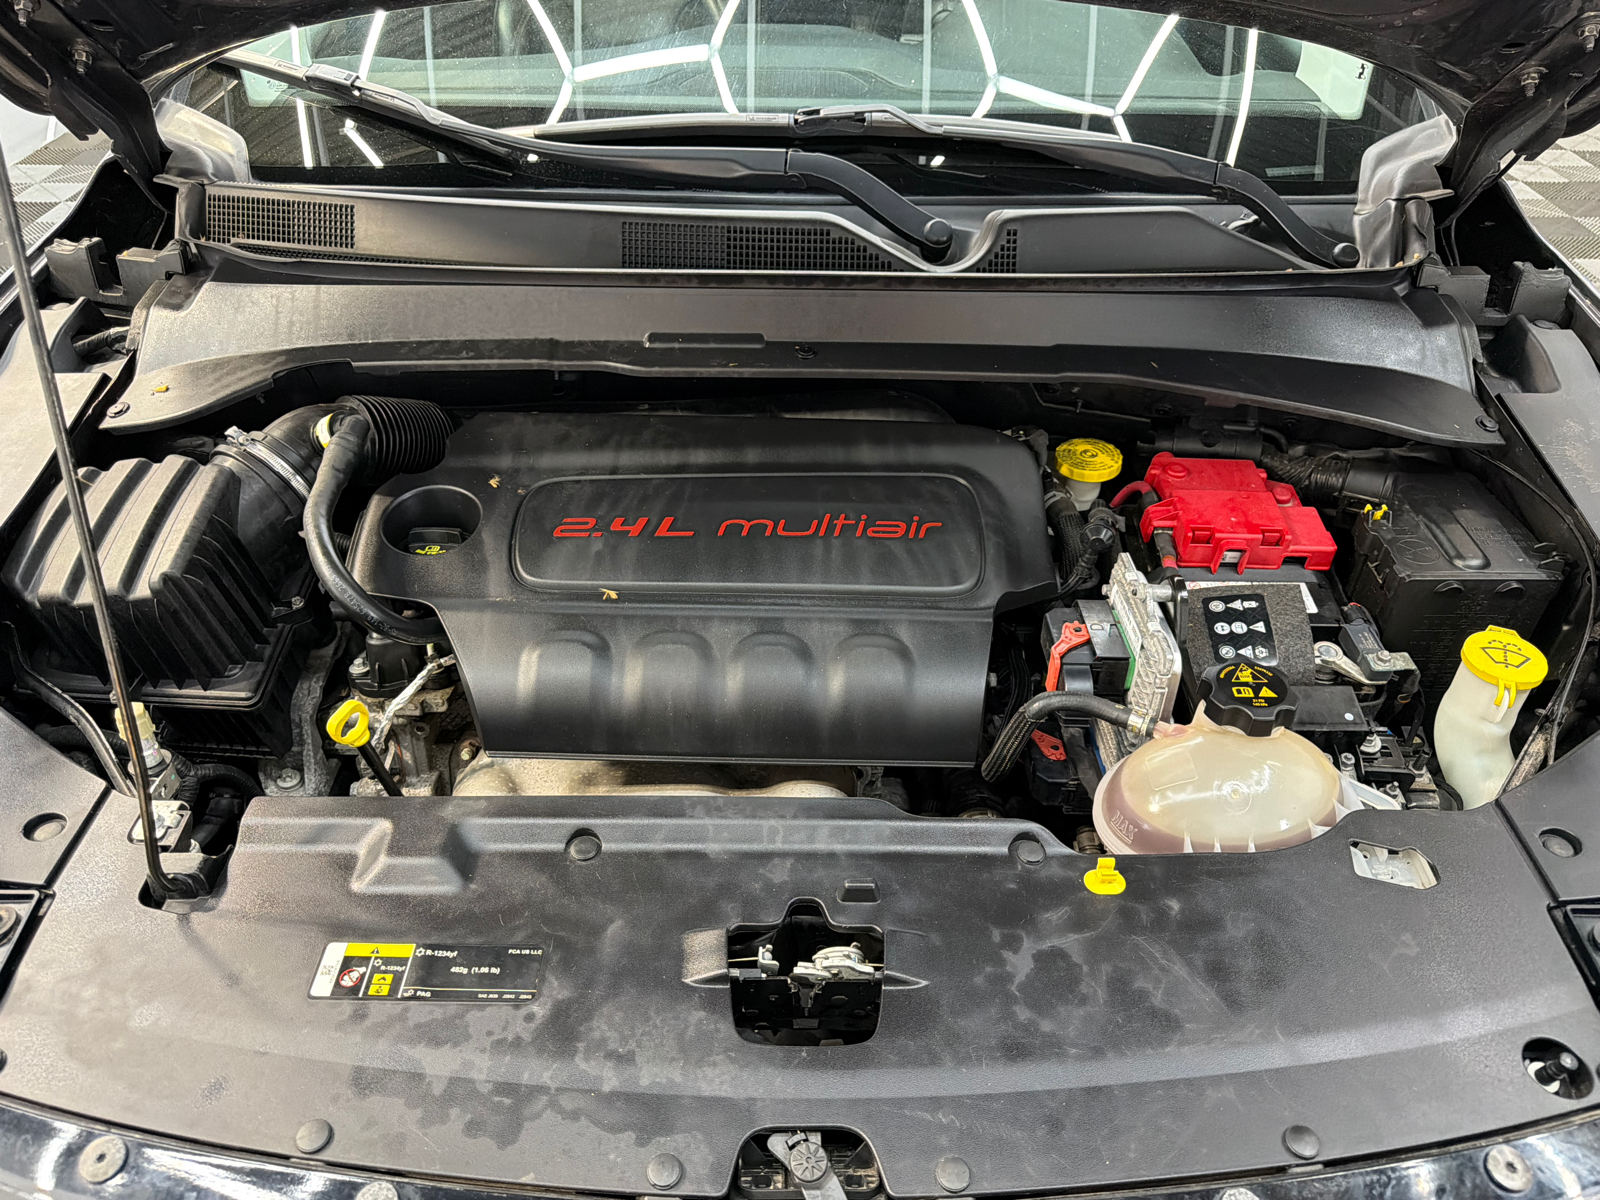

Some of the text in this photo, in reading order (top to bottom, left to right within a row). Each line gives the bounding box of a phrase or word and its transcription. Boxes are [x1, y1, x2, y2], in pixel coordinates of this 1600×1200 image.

[717, 513, 942, 539] multiair
[1111, 810, 1138, 840] MAX
[425, 949, 458, 959] R-1234yf
